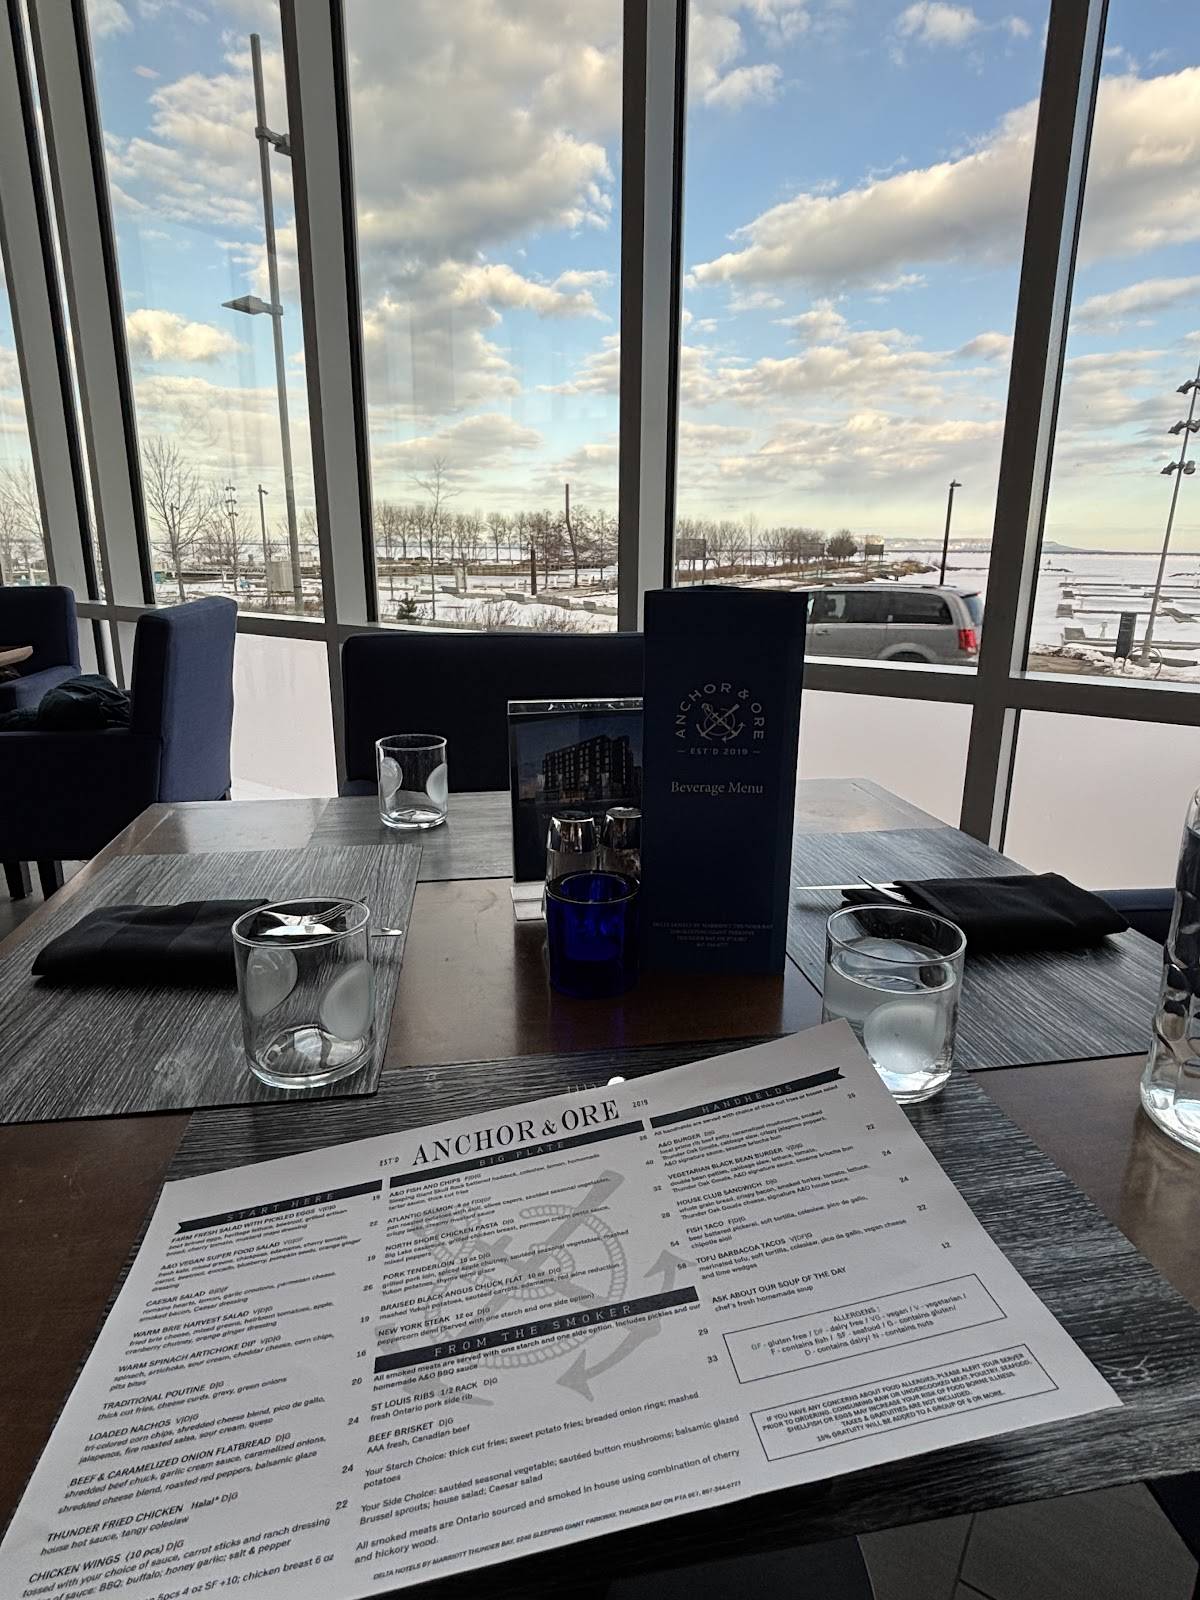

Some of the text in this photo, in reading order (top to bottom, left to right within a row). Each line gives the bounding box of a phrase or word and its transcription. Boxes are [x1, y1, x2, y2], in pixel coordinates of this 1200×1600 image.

[675, 683, 765, 740] ANCHOR & ORE
[671, 781, 763, 796] Beverage Menu
[701, 1084, 791, 1112] HANDHELDS
[414, 1120, 533, 1164] ANCHOR
[541, 1119, 557, 1136] &
[561, 1099, 618, 1130] ORE
[657, 1133, 701, 1148] A&O BURGER
[479, 1141, 563, 1166] BIG PLATE
[667, 1147, 783, 1179] VEGETARIAN BLACK BEAN BURGER
[422, 1182, 438, 1190] AND
[439, 1177, 460, 1186] CHIPS
[676, 1181, 762, 1206] HOUSE CLUB SANDWICH
[226, 1193, 333, 1221] START HERE
[385, 1221, 498, 1251] NORTH SHORE CHICKEN PASTA
[685, 1220, 724, 1234] FISH TACO
[160, 1241, 280, 1270] A&O VEGAN SUPER FOOD SALAD
[695, 1238, 786, 1263] TOFU BARBACOA TACOS
[382, 1259, 454, 1280] PORK TENDERLOIN
[145, 1290, 205, 1306] CAESAR SALAD
[380, 1299, 415, 1311] BRAISED
[416, 1292, 444, 1303] BLACK
[444, 1286, 473, 1297] ANGUS
[474, 1279, 503, 1291] CHUCK
[504, 1275, 522, 1285] FLAT
[712, 1266, 845, 1303] ASK ABOUT OUR SOUP OF THE DAY
[133, 1310, 249, 1337] WARM BRIE HARVEST SALAD
[377, 1327, 398, 1337] NEW
[399, 1321, 422, 1332] YORK
[424, 1315, 450, 1327] STEAK
[434, 1305, 631, 1356] FROM THE SMOKER
[697, 1327, 708, 1336] 29
[118, 1339, 256, 1372] WARM SPINACH ARTICHOKE DIP
[706, 1354, 718, 1363] 33
[351, 1376, 362, 1385] 20
[103, 1384, 205, 1409] TRADITIONAL POUTINE
[370, 1381, 477, 1411] ST LOUIS RIBS 1/2 RACK
[88, 1427, 128, 1441] LOADED
[129, 1418, 171, 1433] NACHOS
[347, 1416, 359, 1425] 24
[364, 1391, 699, 1476] Your Starch Choice: thick cut fries; sweet potato fries; breaded onion rings; mashed
[368, 1430, 391, 1442] BEEF
[393, 1421, 433, 1437] BRISKET
[366, 1423, 470, 1454] AAA fresh, Canadian beef
[68, 1474, 96, 1487] BEEF
[96, 1472, 104, 1481] &
[107, 1457, 178, 1479] CARAMELIZED
[180, 1449, 214, 1463] ONION
[215, 1436, 271, 1455] FLATBREAD
[341, 1463, 353, 1474] 24
[335, 1499, 348, 1510] 22
[355, 1540, 368, 1551] All
[370, 1530, 407, 1547] smoked
[408, 1524, 437, 1537] meats
[438, 1520, 454, 1530] are
[455, 1511, 489, 1525] Ontario
[491, 1500, 526, 1516] sourced
[528, 1495, 545, 1507] and
[547, 1486, 581, 1502] smoked
[593, 1479, 620, 1490] house
[621, 1472, 645, 1483] using
[647, 1459, 700, 1477] combination
[701, 1454, 711, 1463] of
[712, 1449, 739, 1461] cherry
[47, 1523, 99, 1542] THUNDER
[101, 1515, 134, 1530] FRIED
[135, 1504, 183, 1522] CHICKEN
[22, 1518, 330, 1597] tossed with your choice of sauce, carrot sticks and ranch dressing
[28, 1563, 80, 1583] CHICKEN
[82, 1553, 120, 1570] WINGS
